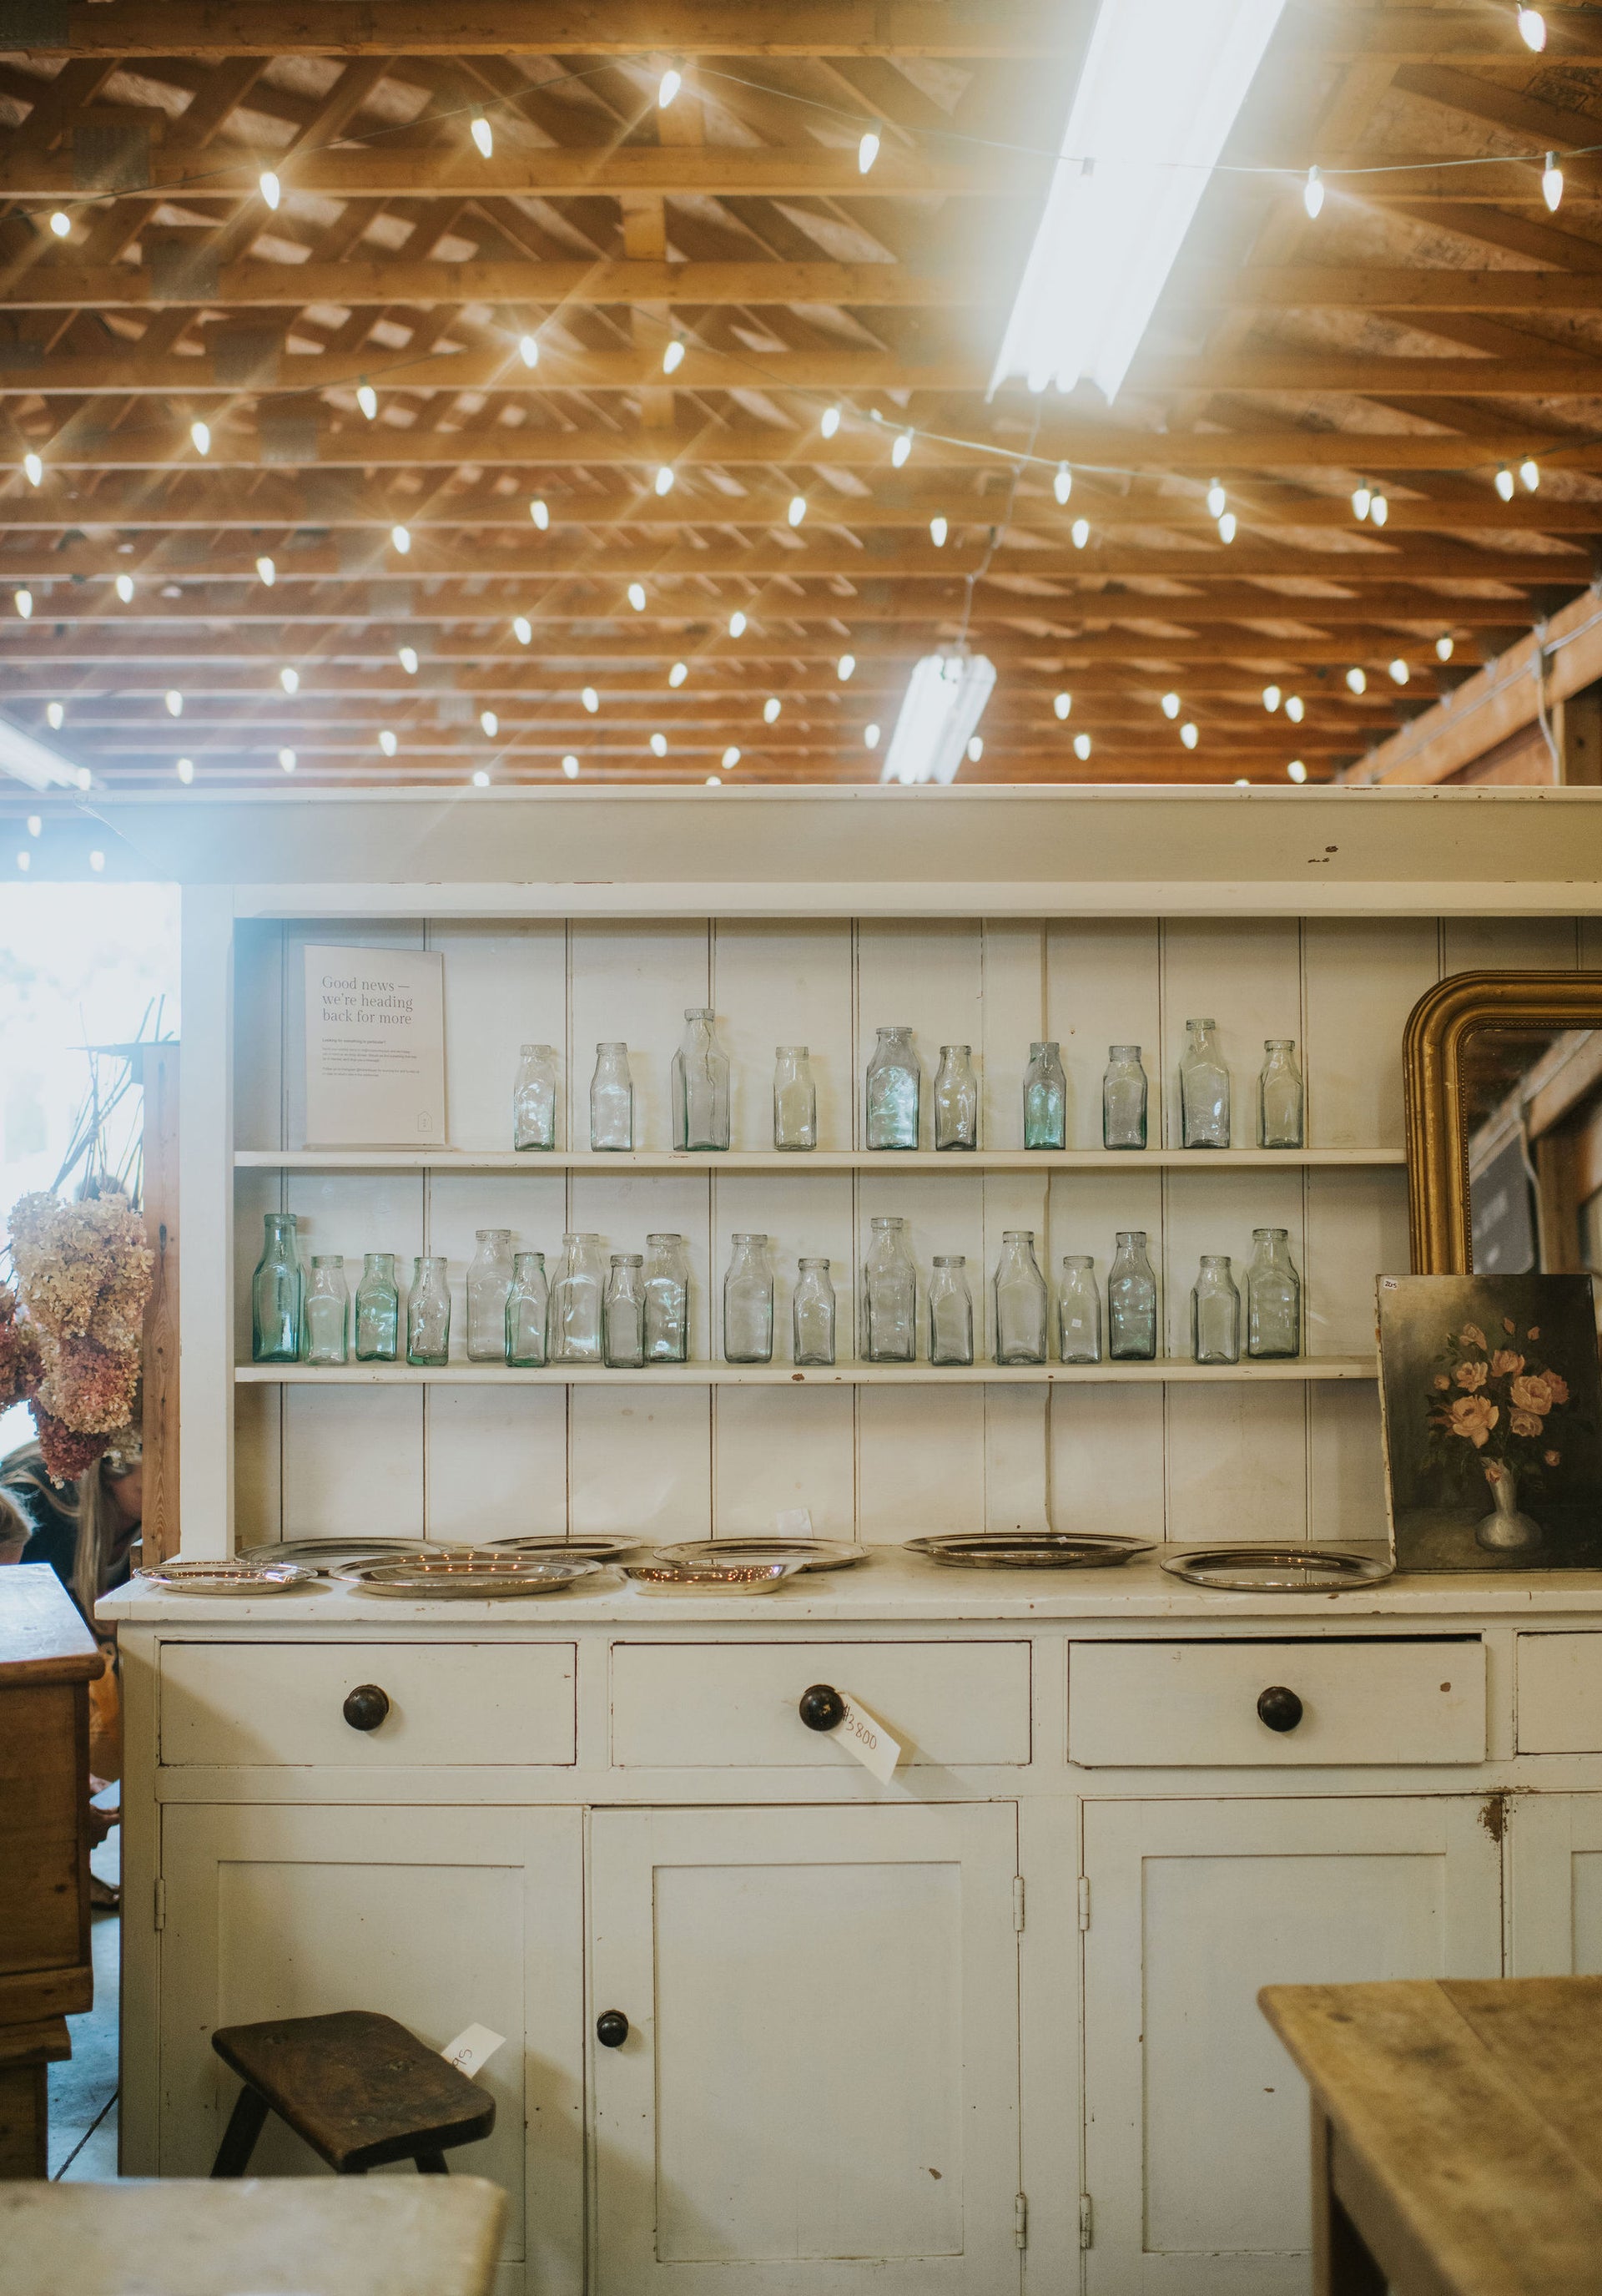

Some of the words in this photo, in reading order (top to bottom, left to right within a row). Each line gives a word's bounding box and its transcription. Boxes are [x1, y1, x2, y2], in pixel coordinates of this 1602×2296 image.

[322, 975, 357, 989] Good
[361, 981, 395, 992] news
[361, 993, 413, 1012] heading
[323, 1007, 353, 1022] back
[357, 1010, 375, 1022] for
[380, 1014, 411, 1025] more
